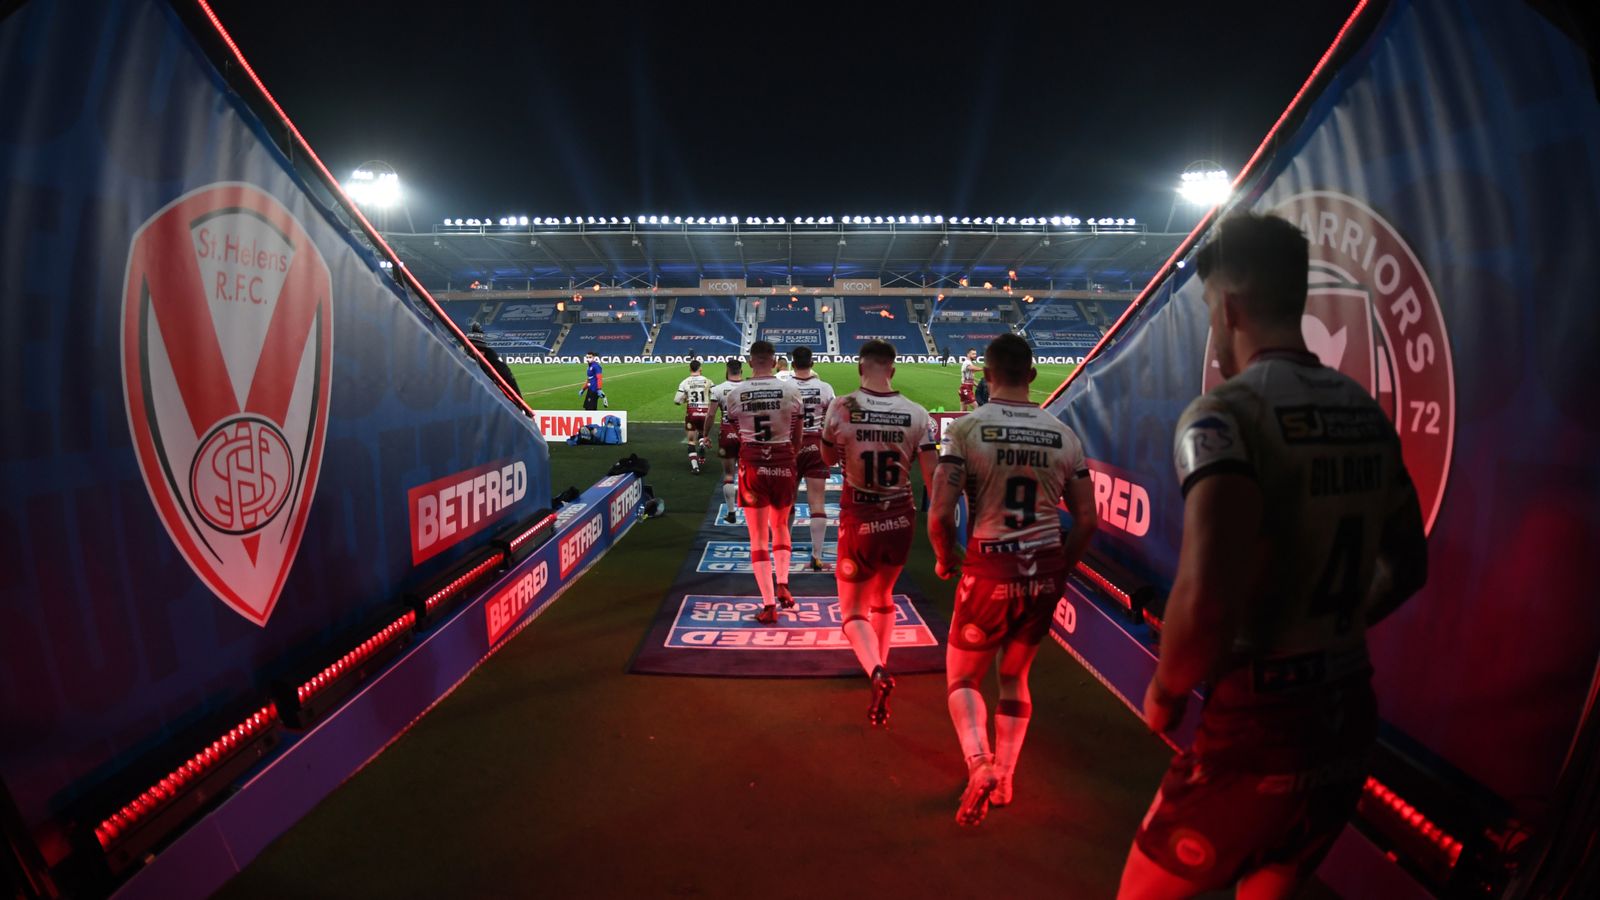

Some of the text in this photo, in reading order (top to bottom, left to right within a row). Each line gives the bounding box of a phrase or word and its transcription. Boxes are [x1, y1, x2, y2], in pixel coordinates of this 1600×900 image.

[216, 271, 267, 304] R.F.C.
[708, 282, 738, 291] KCOM
[843, 282, 872, 291] KCOM
[1293, 211, 1435, 373] ARRIORS
[506, 356, 542, 364] DACIA
[544, 356, 580, 364] DACIA
[624, 356, 662, 364] DACIA
[917, 356, 956, 364] DACA
[1038, 356, 1075, 364] DACIA
[690, 390, 705, 403] 31
[851, 411, 869, 422] SJ
[1410, 401, 1441, 435] 72
[754, 415, 771, 441] 5
[856, 429, 904, 443] SMITHIES
[983, 427, 1059, 440] SJ SPECIALIST
[1008, 434, 1035, 442] CARS
[996, 448, 1049, 468] POWELL
[860, 450, 900, 488] 16
[418, 461, 527, 551] BETFRED
[610, 478, 642, 529] BETFRED
[1004, 475, 1037, 529] 9
[870, 518, 900, 533] Holts
[561, 513, 603, 574] BETFRED
[489, 560, 548, 643] BETFRED
[681, 629, 918, 646] BTFRED
